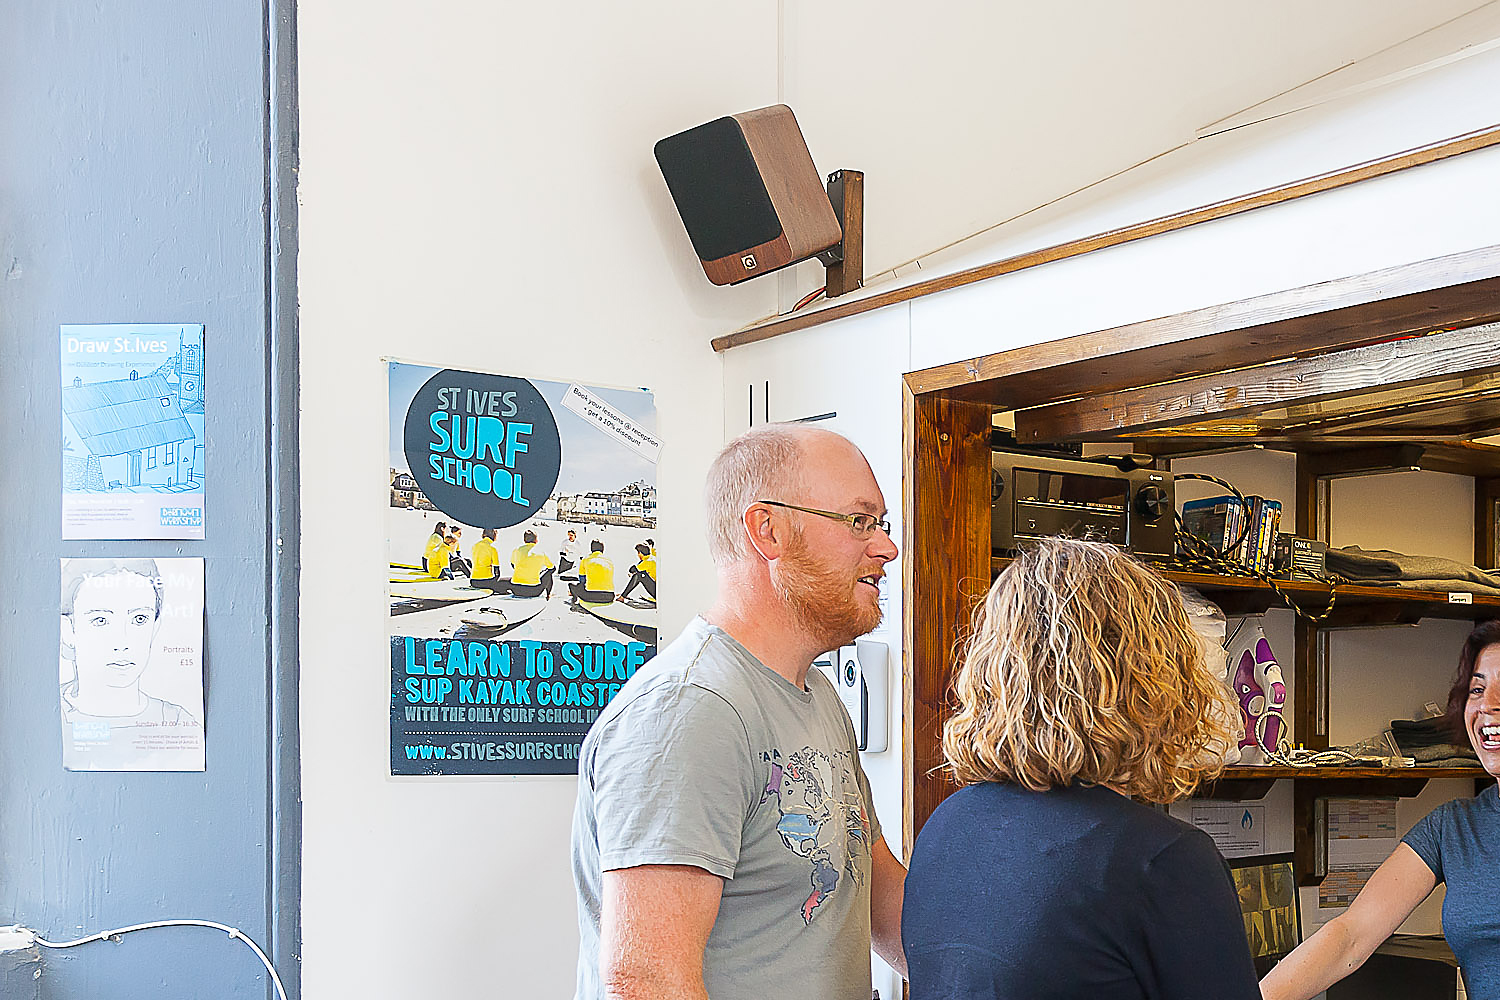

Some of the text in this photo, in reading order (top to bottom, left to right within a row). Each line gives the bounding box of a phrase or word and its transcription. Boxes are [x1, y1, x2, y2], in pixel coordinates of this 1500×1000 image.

[67, 336, 168, 354] Draw St.Ives
[437, 387, 518, 418] ST IVES
[573, 386, 588, 405] Book
[587, 398, 603, 414] your
[602, 404, 624, 427] lessons
[631, 425, 660, 448] reception
[429, 410, 534, 469] SURF
[587, 408, 599, 421] get
[603, 416, 616, 431] 10%
[615, 426, 641, 448] discount
[429, 454, 530, 507] SCHOOL
[163, 646, 194, 654] Portraits
[404, 636, 646, 680] LEARN To SURF
[405, 677, 453, 704] SUP
[459, 678, 531, 705] KAYAK
[405, 706, 598, 724] WITH THE ONLY SURF SCHOOL IN
